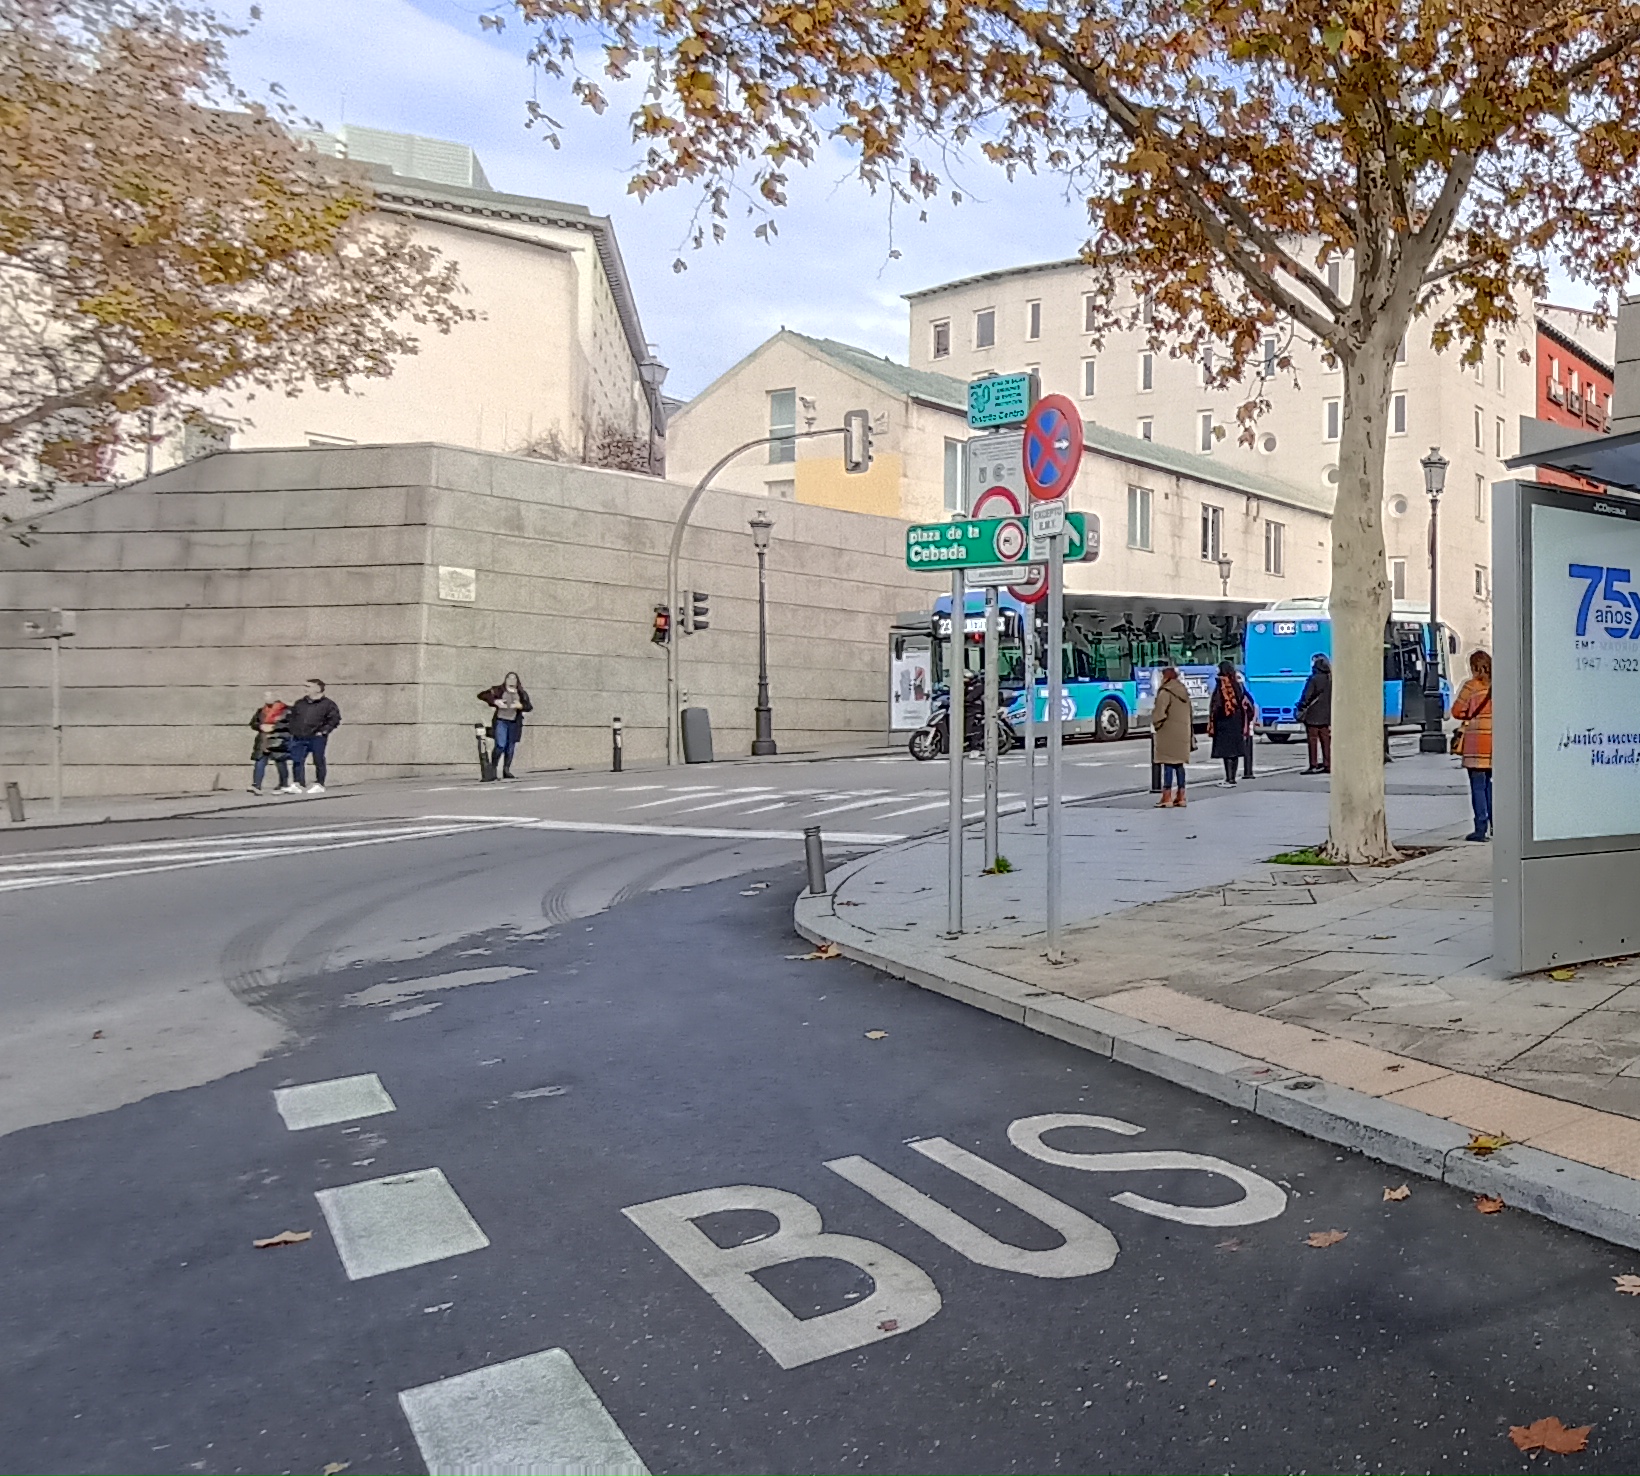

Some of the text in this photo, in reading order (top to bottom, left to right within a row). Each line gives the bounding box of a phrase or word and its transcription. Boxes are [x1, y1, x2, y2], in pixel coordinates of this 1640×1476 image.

[999, 410, 1024, 419] Centro
[1034, 506, 1062, 520] EXCEPTO
[908, 525, 980, 544] plaza de la
[910, 542, 967, 562] Cebada
[1568, 563, 1631, 638] 75
[1595, 605, 1632, 624] años
[1575, 640, 1639, 652] EMT MADRID
[1576, 657, 1601, 671] 1947
[1613, 658, 1639, 672] 2022
[620, 1113, 1288, 1370] BUS
